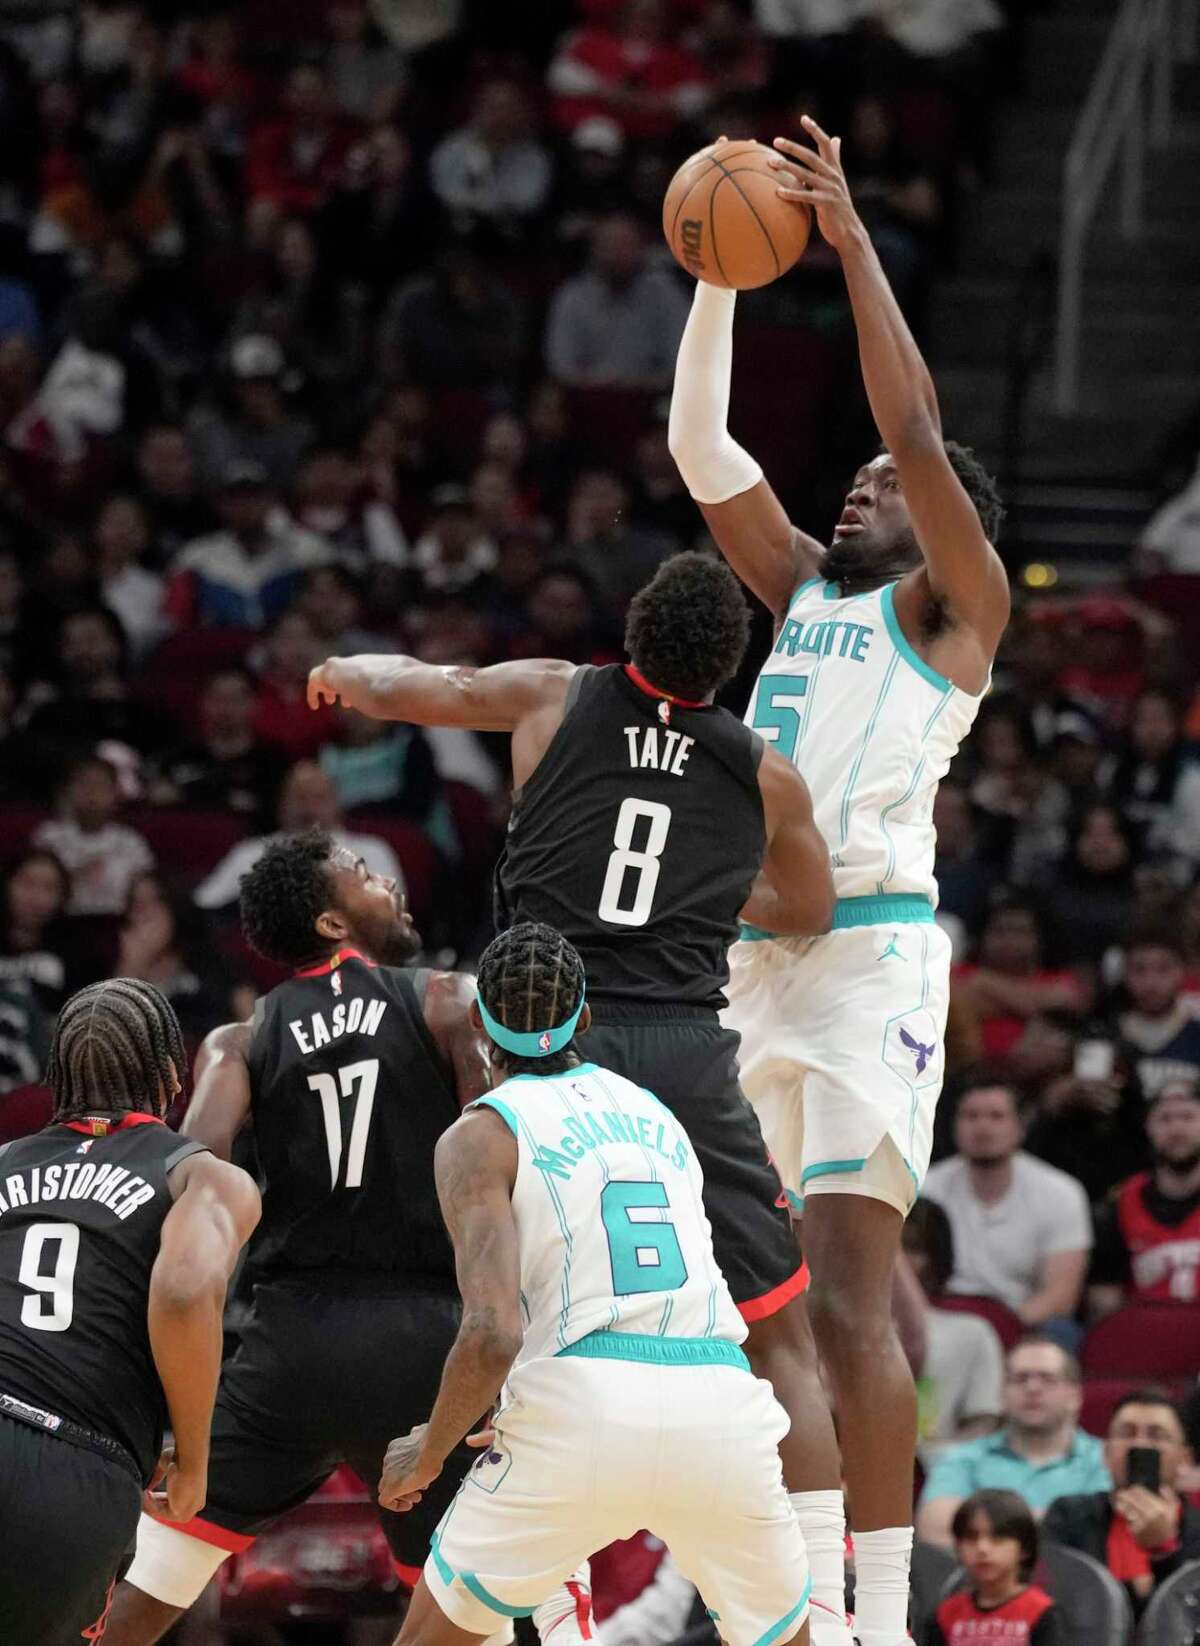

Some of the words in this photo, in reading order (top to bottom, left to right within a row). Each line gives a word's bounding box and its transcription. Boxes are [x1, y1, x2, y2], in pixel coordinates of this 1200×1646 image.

[623, 726, 695, 777] TATE
[752, 674, 808, 761] 5
[598, 797, 672, 927] 8
[289, 997, 387, 1055] EASON
[307, 1058, 379, 1193] 17
[532, 1111, 689, 1181] McDANIELS
[0, 1162, 156, 1221] RISTOPHER
[18, 1222, 80, 1332] 9
[600, 1180, 689, 1297] 6
